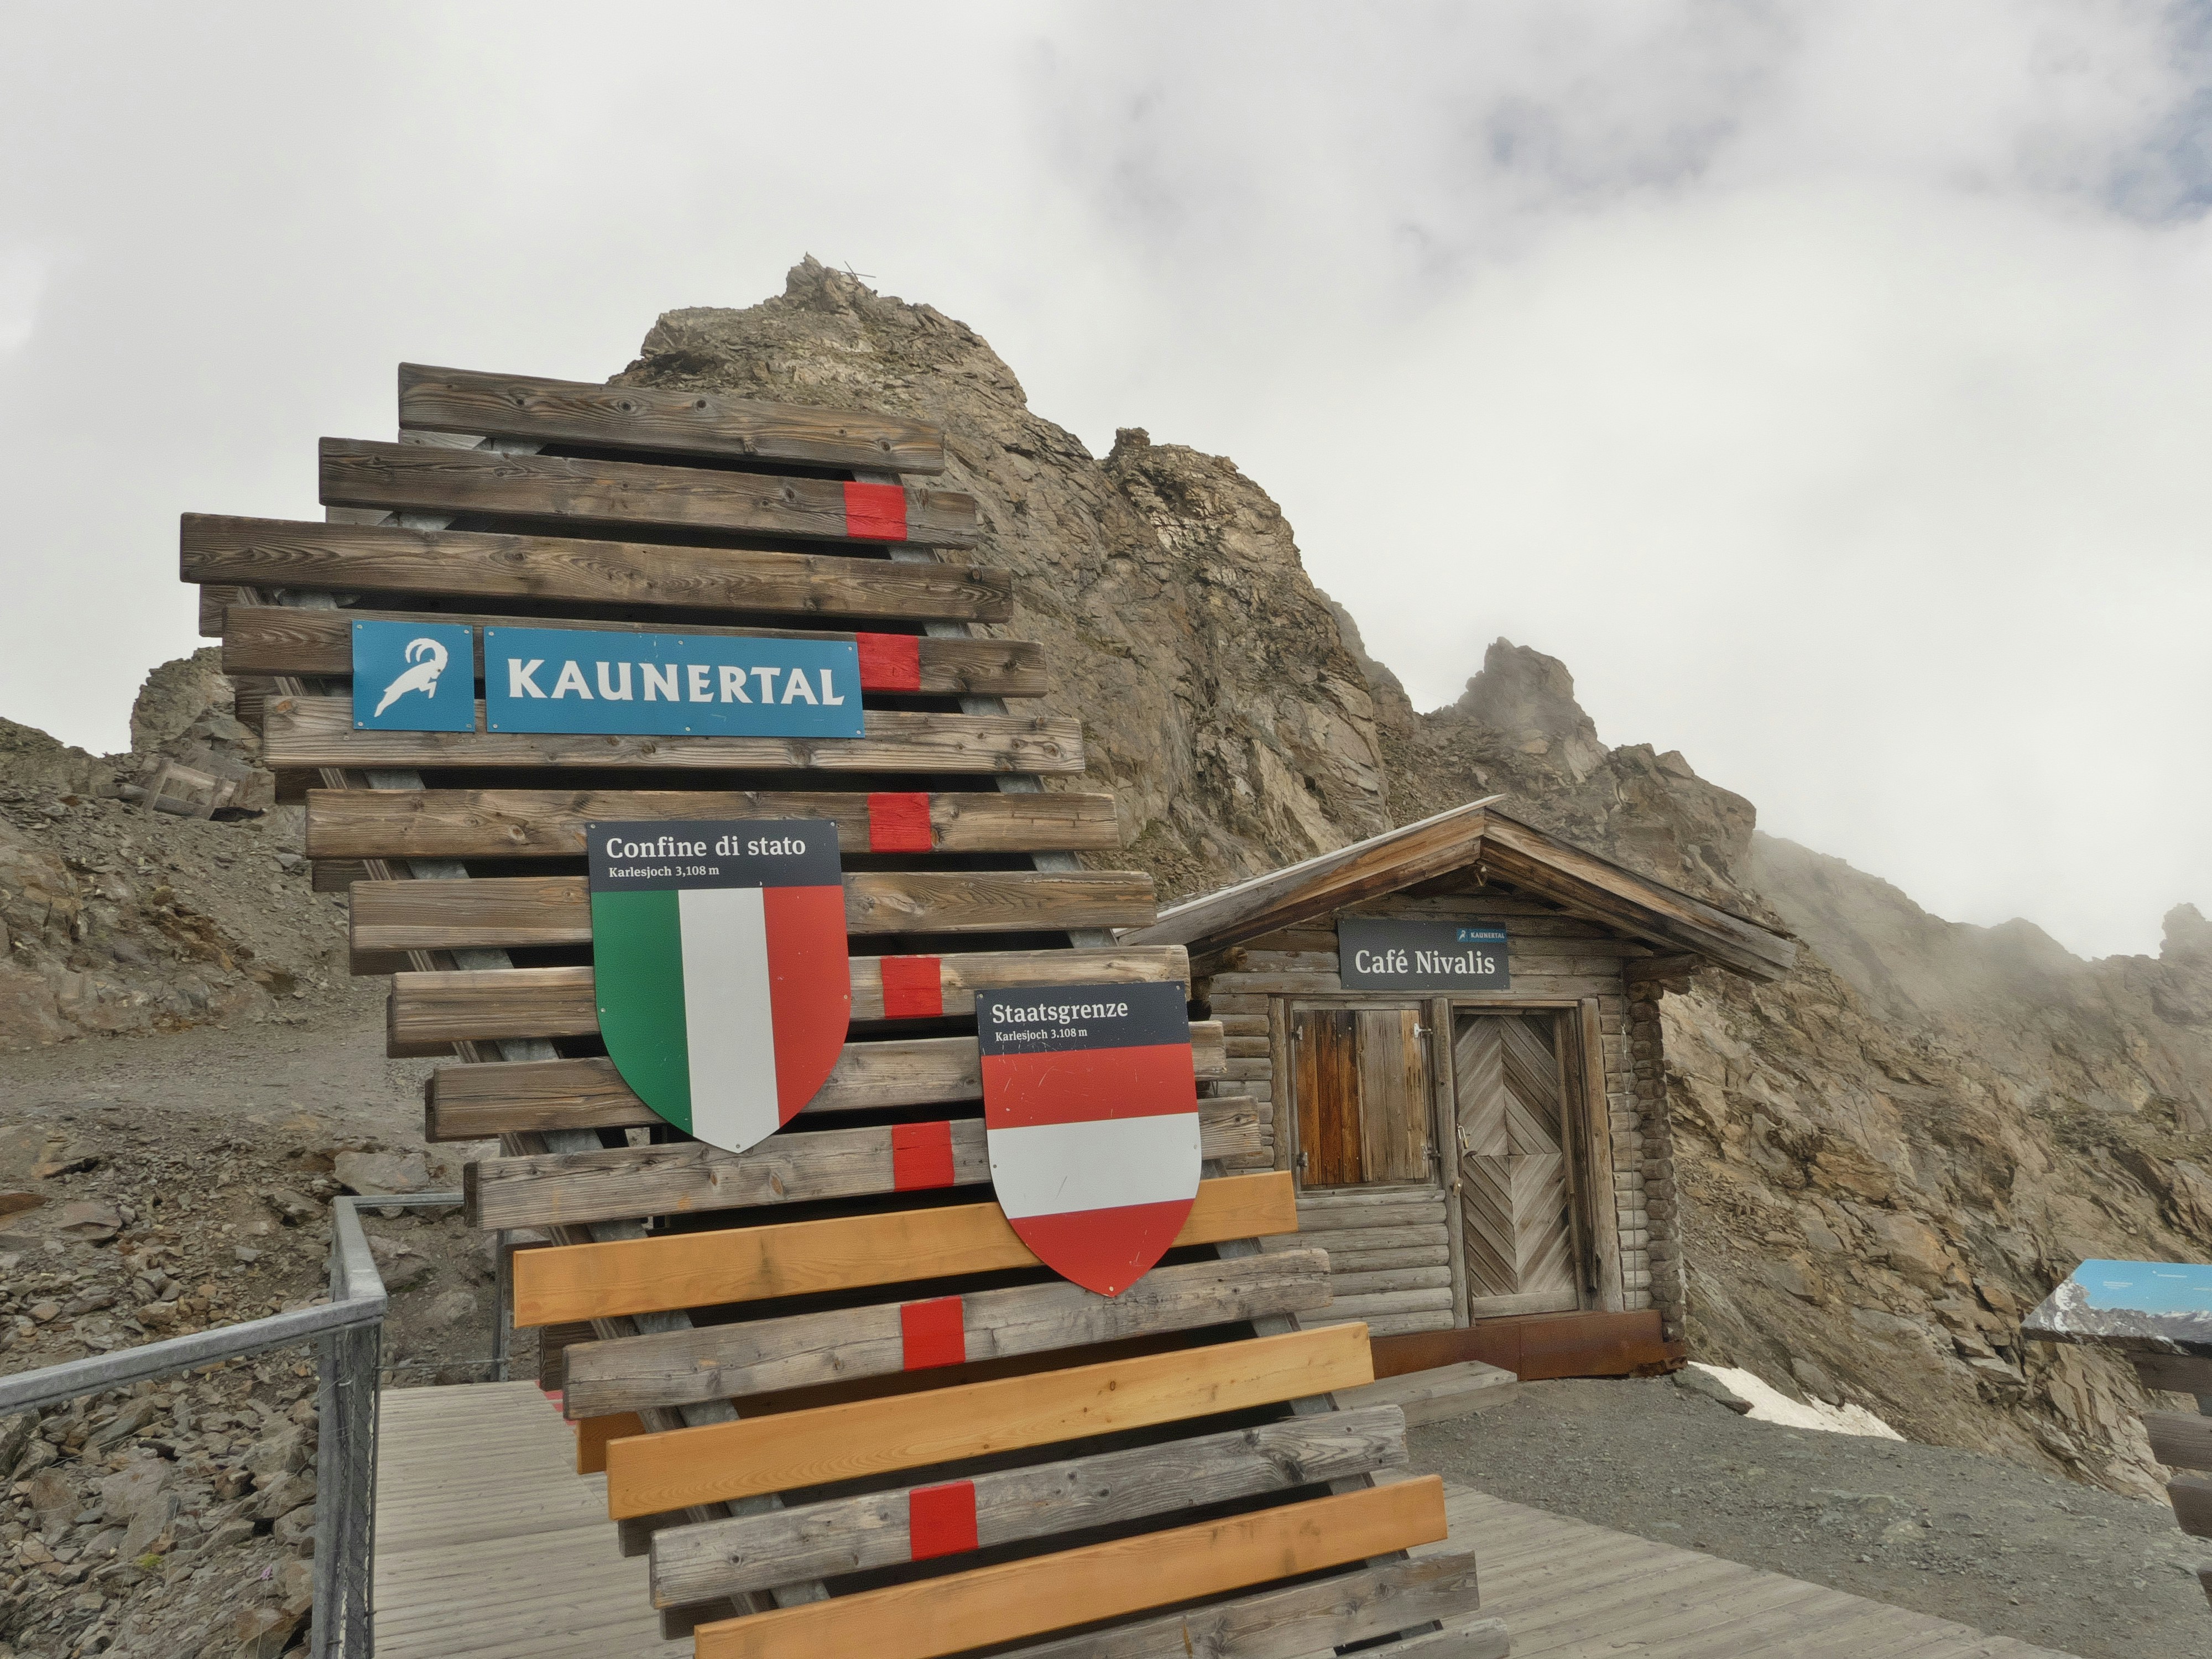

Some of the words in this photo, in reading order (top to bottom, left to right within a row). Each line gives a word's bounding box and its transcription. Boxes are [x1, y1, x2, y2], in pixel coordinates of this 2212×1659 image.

[507, 658, 846, 705] KAUNERTAL
[607, 836, 707, 858] Confine
[715, 835, 740, 856] di
[748, 837, 806, 855] stato
[609, 866, 672, 879] Karlesjoch
[675, 866, 707, 877] 3,108
[708, 867, 719, 875] m
[1355, 949, 1408, 973] Café
[1415, 950, 1495, 974] Nivalis
[992, 1002, 1129, 1024] Staatsgrenze
[995, 1029, 1048, 1042] Karlesjoch
[1051, 1028, 1077, 1039] 3.108
